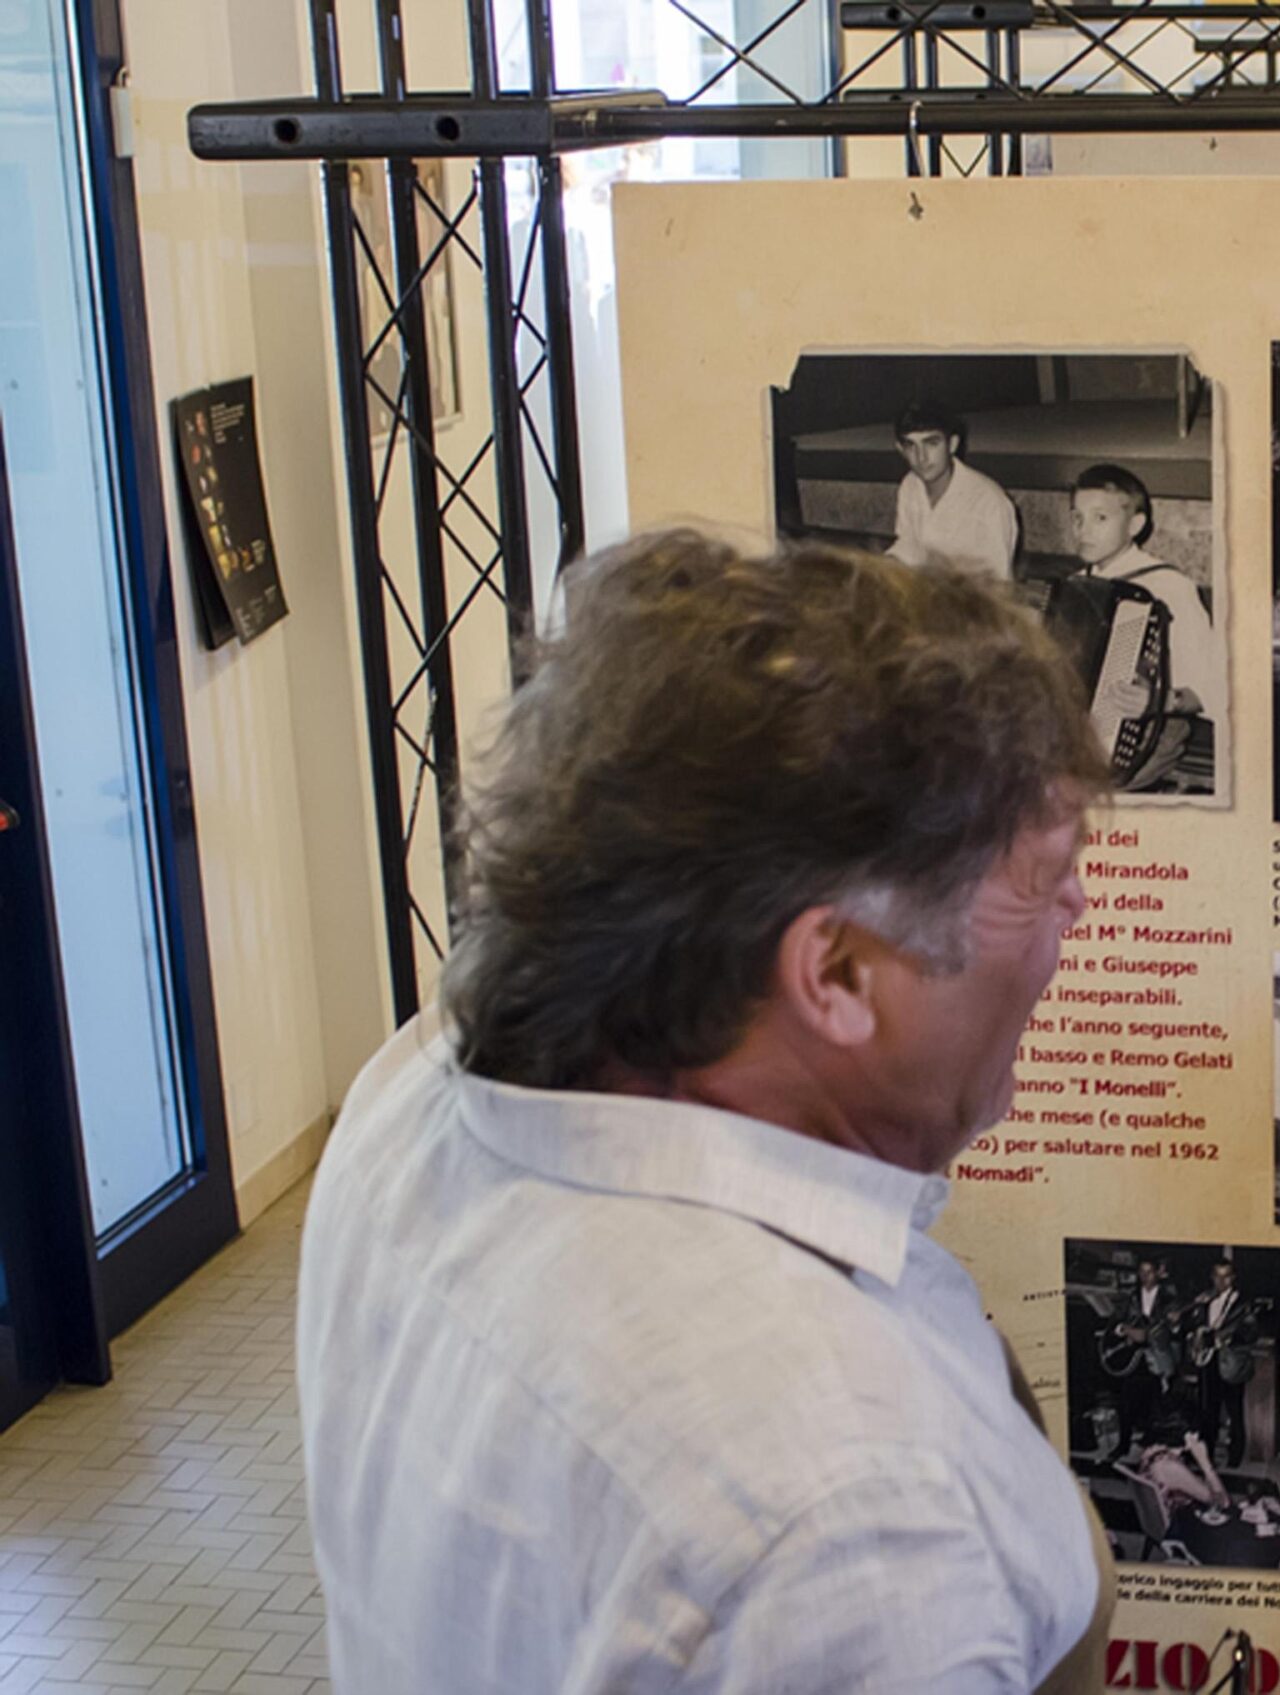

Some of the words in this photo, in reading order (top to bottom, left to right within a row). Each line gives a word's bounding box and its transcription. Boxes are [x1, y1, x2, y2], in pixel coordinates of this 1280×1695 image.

[1107, 829, 1139, 847] dei
[1086, 861, 1189, 880] Mirandola
[1113, 894, 1164, 911] della
[1061, 925, 1092, 942] del
[1133, 926, 1233, 945] Mozzarini
[1084, 960, 1097, 973] e
[1102, 956, 1198, 977] Giuseppe
[1057, 985, 1183, 1006] inseparabili.
[1128, 1020, 1229, 1041] seguente,
[1030, 1046, 1088, 1064] basso
[1092, 1051, 1105, 1066] e
[1110, 1049, 1170, 1067] Remo
[1174, 1051, 1234, 1070] Gelati
[1041, 1110, 1094, 1125] mese
[1099, 1108, 1121, 1129] (e
[1126, 1111, 1207, 1131] qualche
[1004, 1139, 1038, 1156] per
[1043, 1138, 1126, 1158] salutare
[1130, 1141, 1162, 1158] nel
[1168, 1142, 1220, 1161] 1962
[1159, 1574, 1224, 1591] ingaggio
[1228, 1580, 1253, 1592] per
[1134, 1590, 1171, 1602] della
[1175, 1593, 1233, 1606] carriera
[1236, 1595, 1260, 1608] dei
